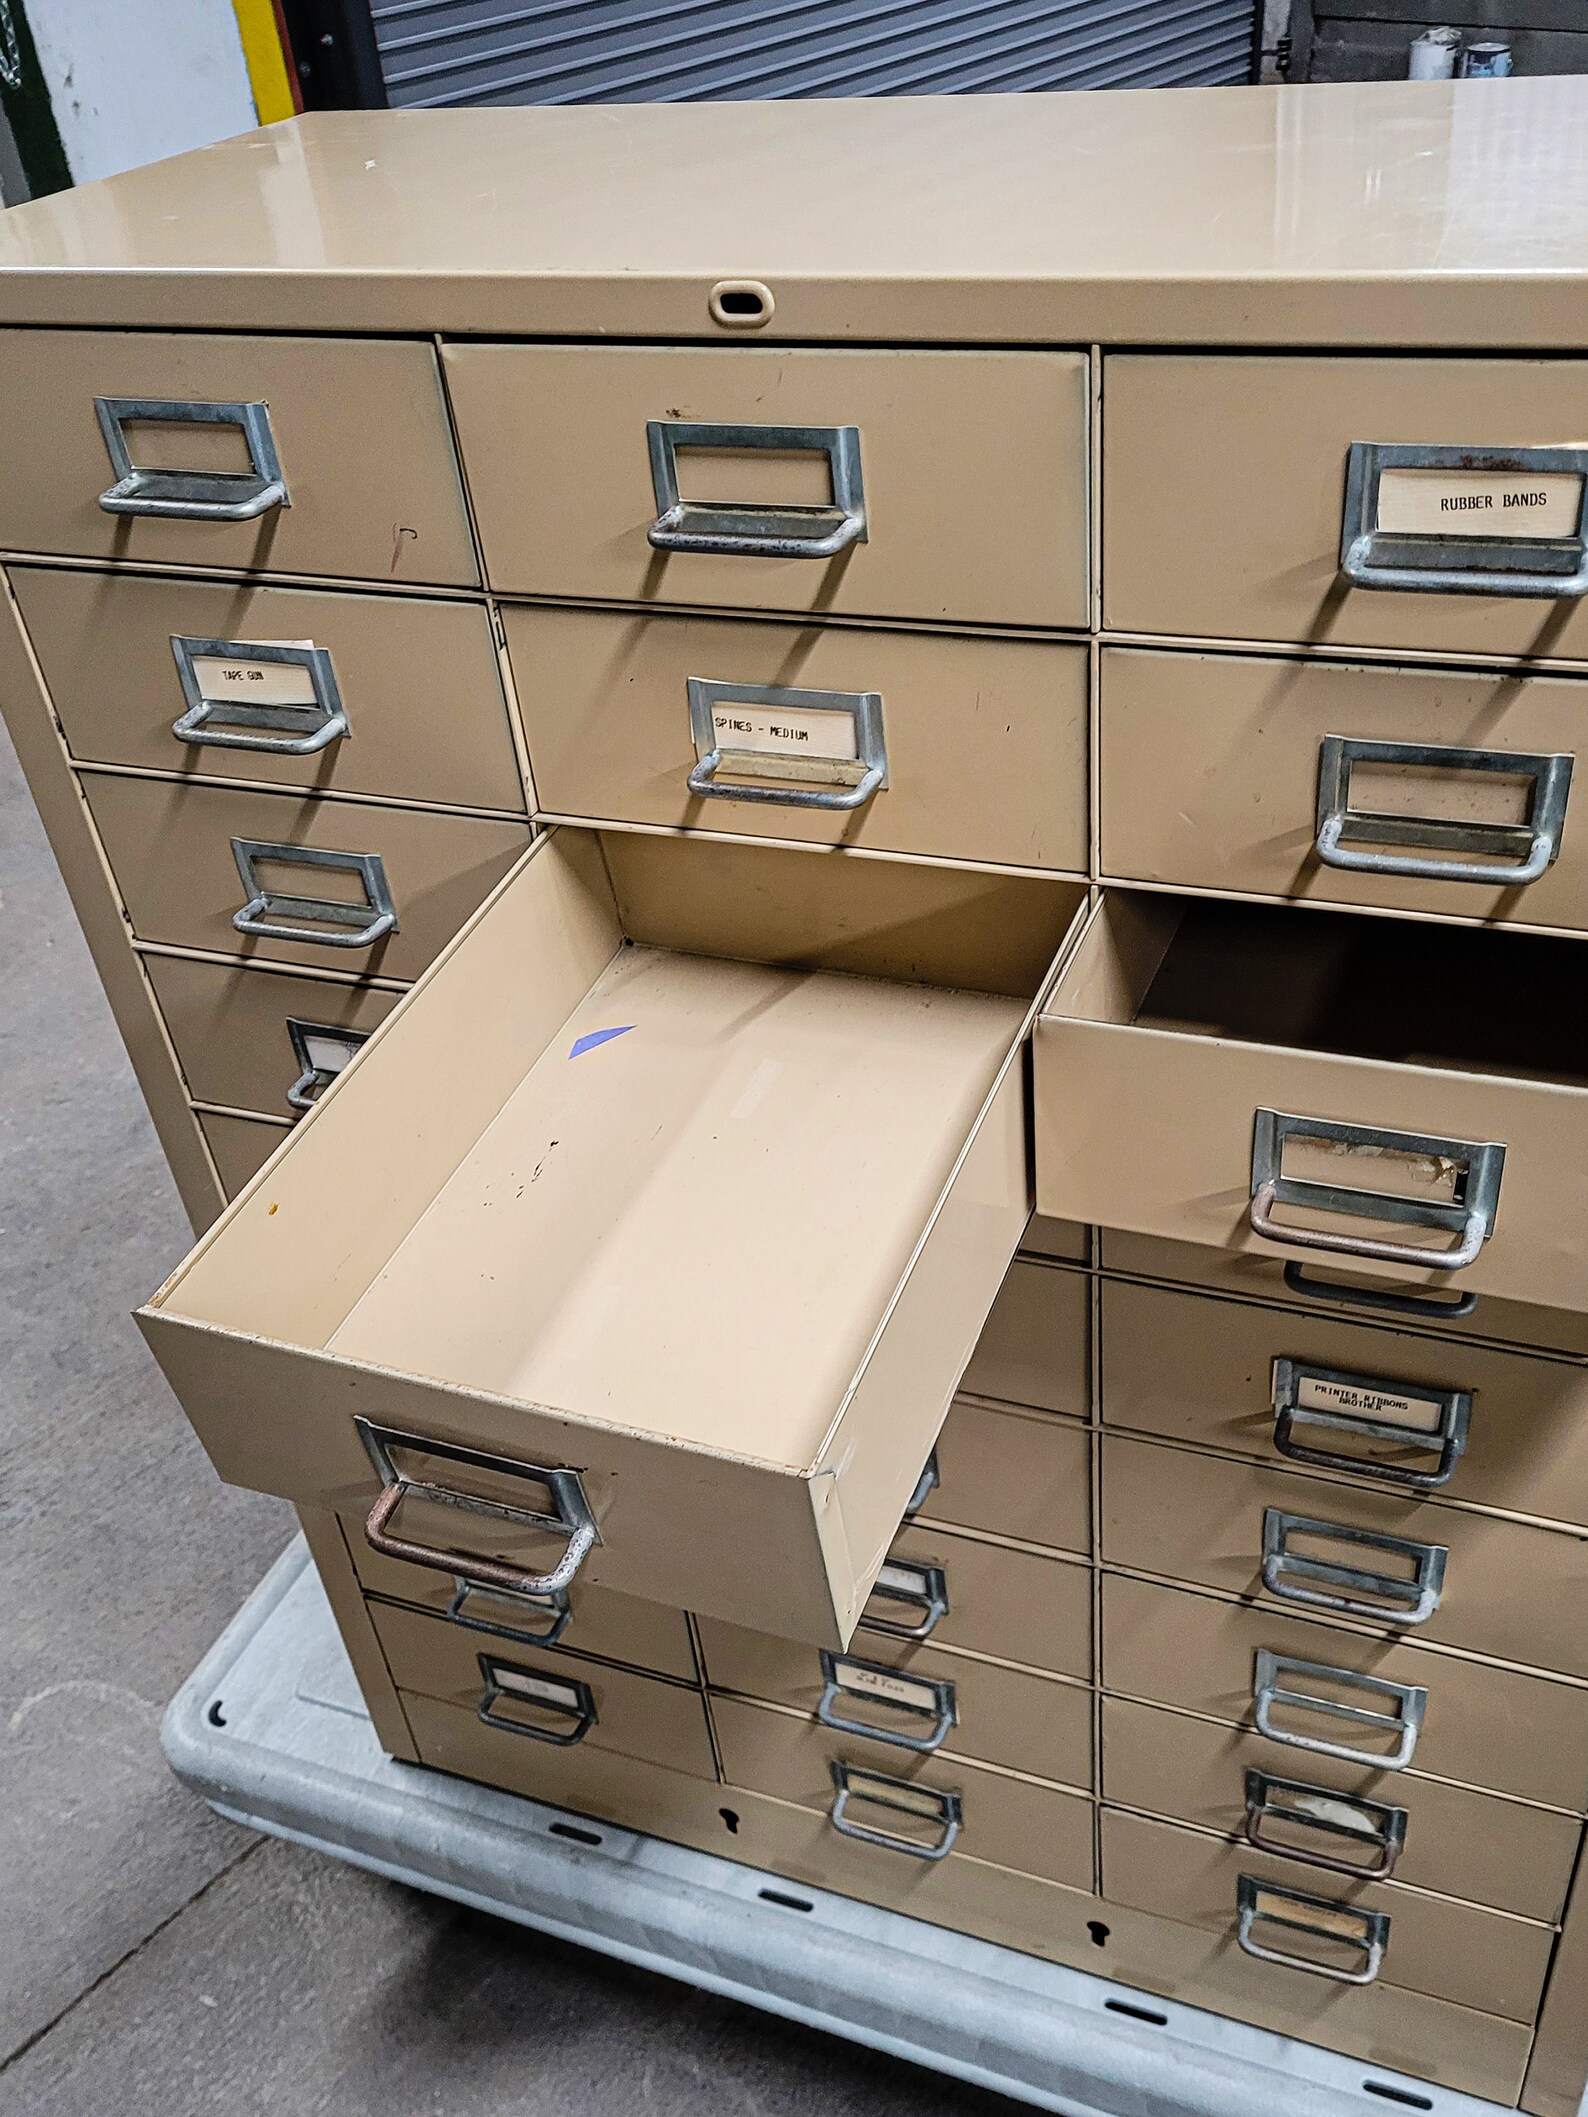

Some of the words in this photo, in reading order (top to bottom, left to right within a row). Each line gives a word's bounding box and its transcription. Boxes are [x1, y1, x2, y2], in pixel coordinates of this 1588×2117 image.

[1441, 495, 1493, 511] RUBBER
[1503, 492, 1547, 507] BANDS
[222, 670, 244, 680] TAPE
[714, 717, 752, 732] SPINES
[770, 726, 808, 741] MEDIUM
[1315, 1384, 1358, 1399] PRINTER
[1364, 1394, 1408, 1410] RIBBONS
[1339, 1397, 1382, 1411] BROTHER
